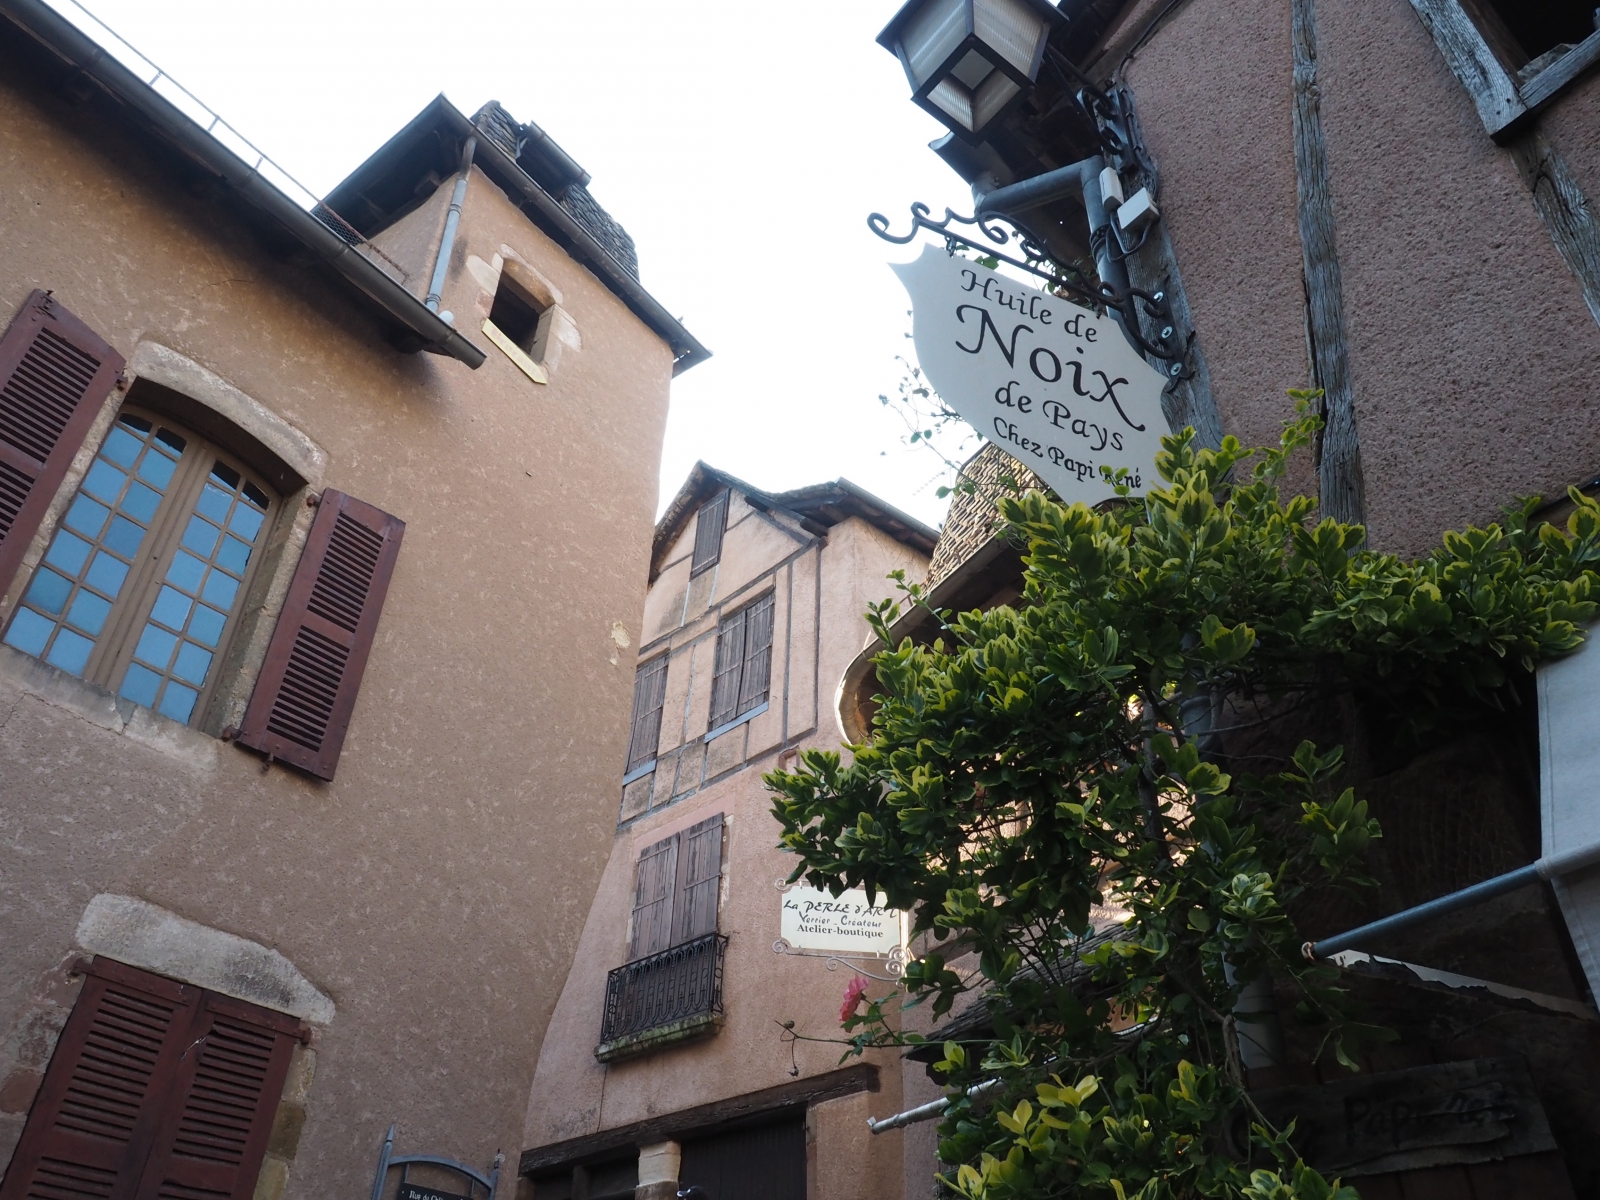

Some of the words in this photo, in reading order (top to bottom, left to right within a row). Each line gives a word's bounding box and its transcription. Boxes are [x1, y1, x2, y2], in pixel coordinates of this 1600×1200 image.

[960, 269, 1053, 326] Huile
[1063, 313, 1098, 343] de
[955, 304, 1146, 432] Noix
[995, 380, 1032, 414] de
[1042, 400, 1123, 452] Pays
[993, 417, 1044, 458] Chez
[1047, 446, 1096, 483] Papi
[783, 899, 799, 910] La
[803, 900, 850, 914] PERLE
[798, 910, 831, 925] Verrier
[840, 914, 882, 928] Créateur
[797, 924, 884, 938] Atelier-boutique
[409, 1190, 421, 1200] Rue
